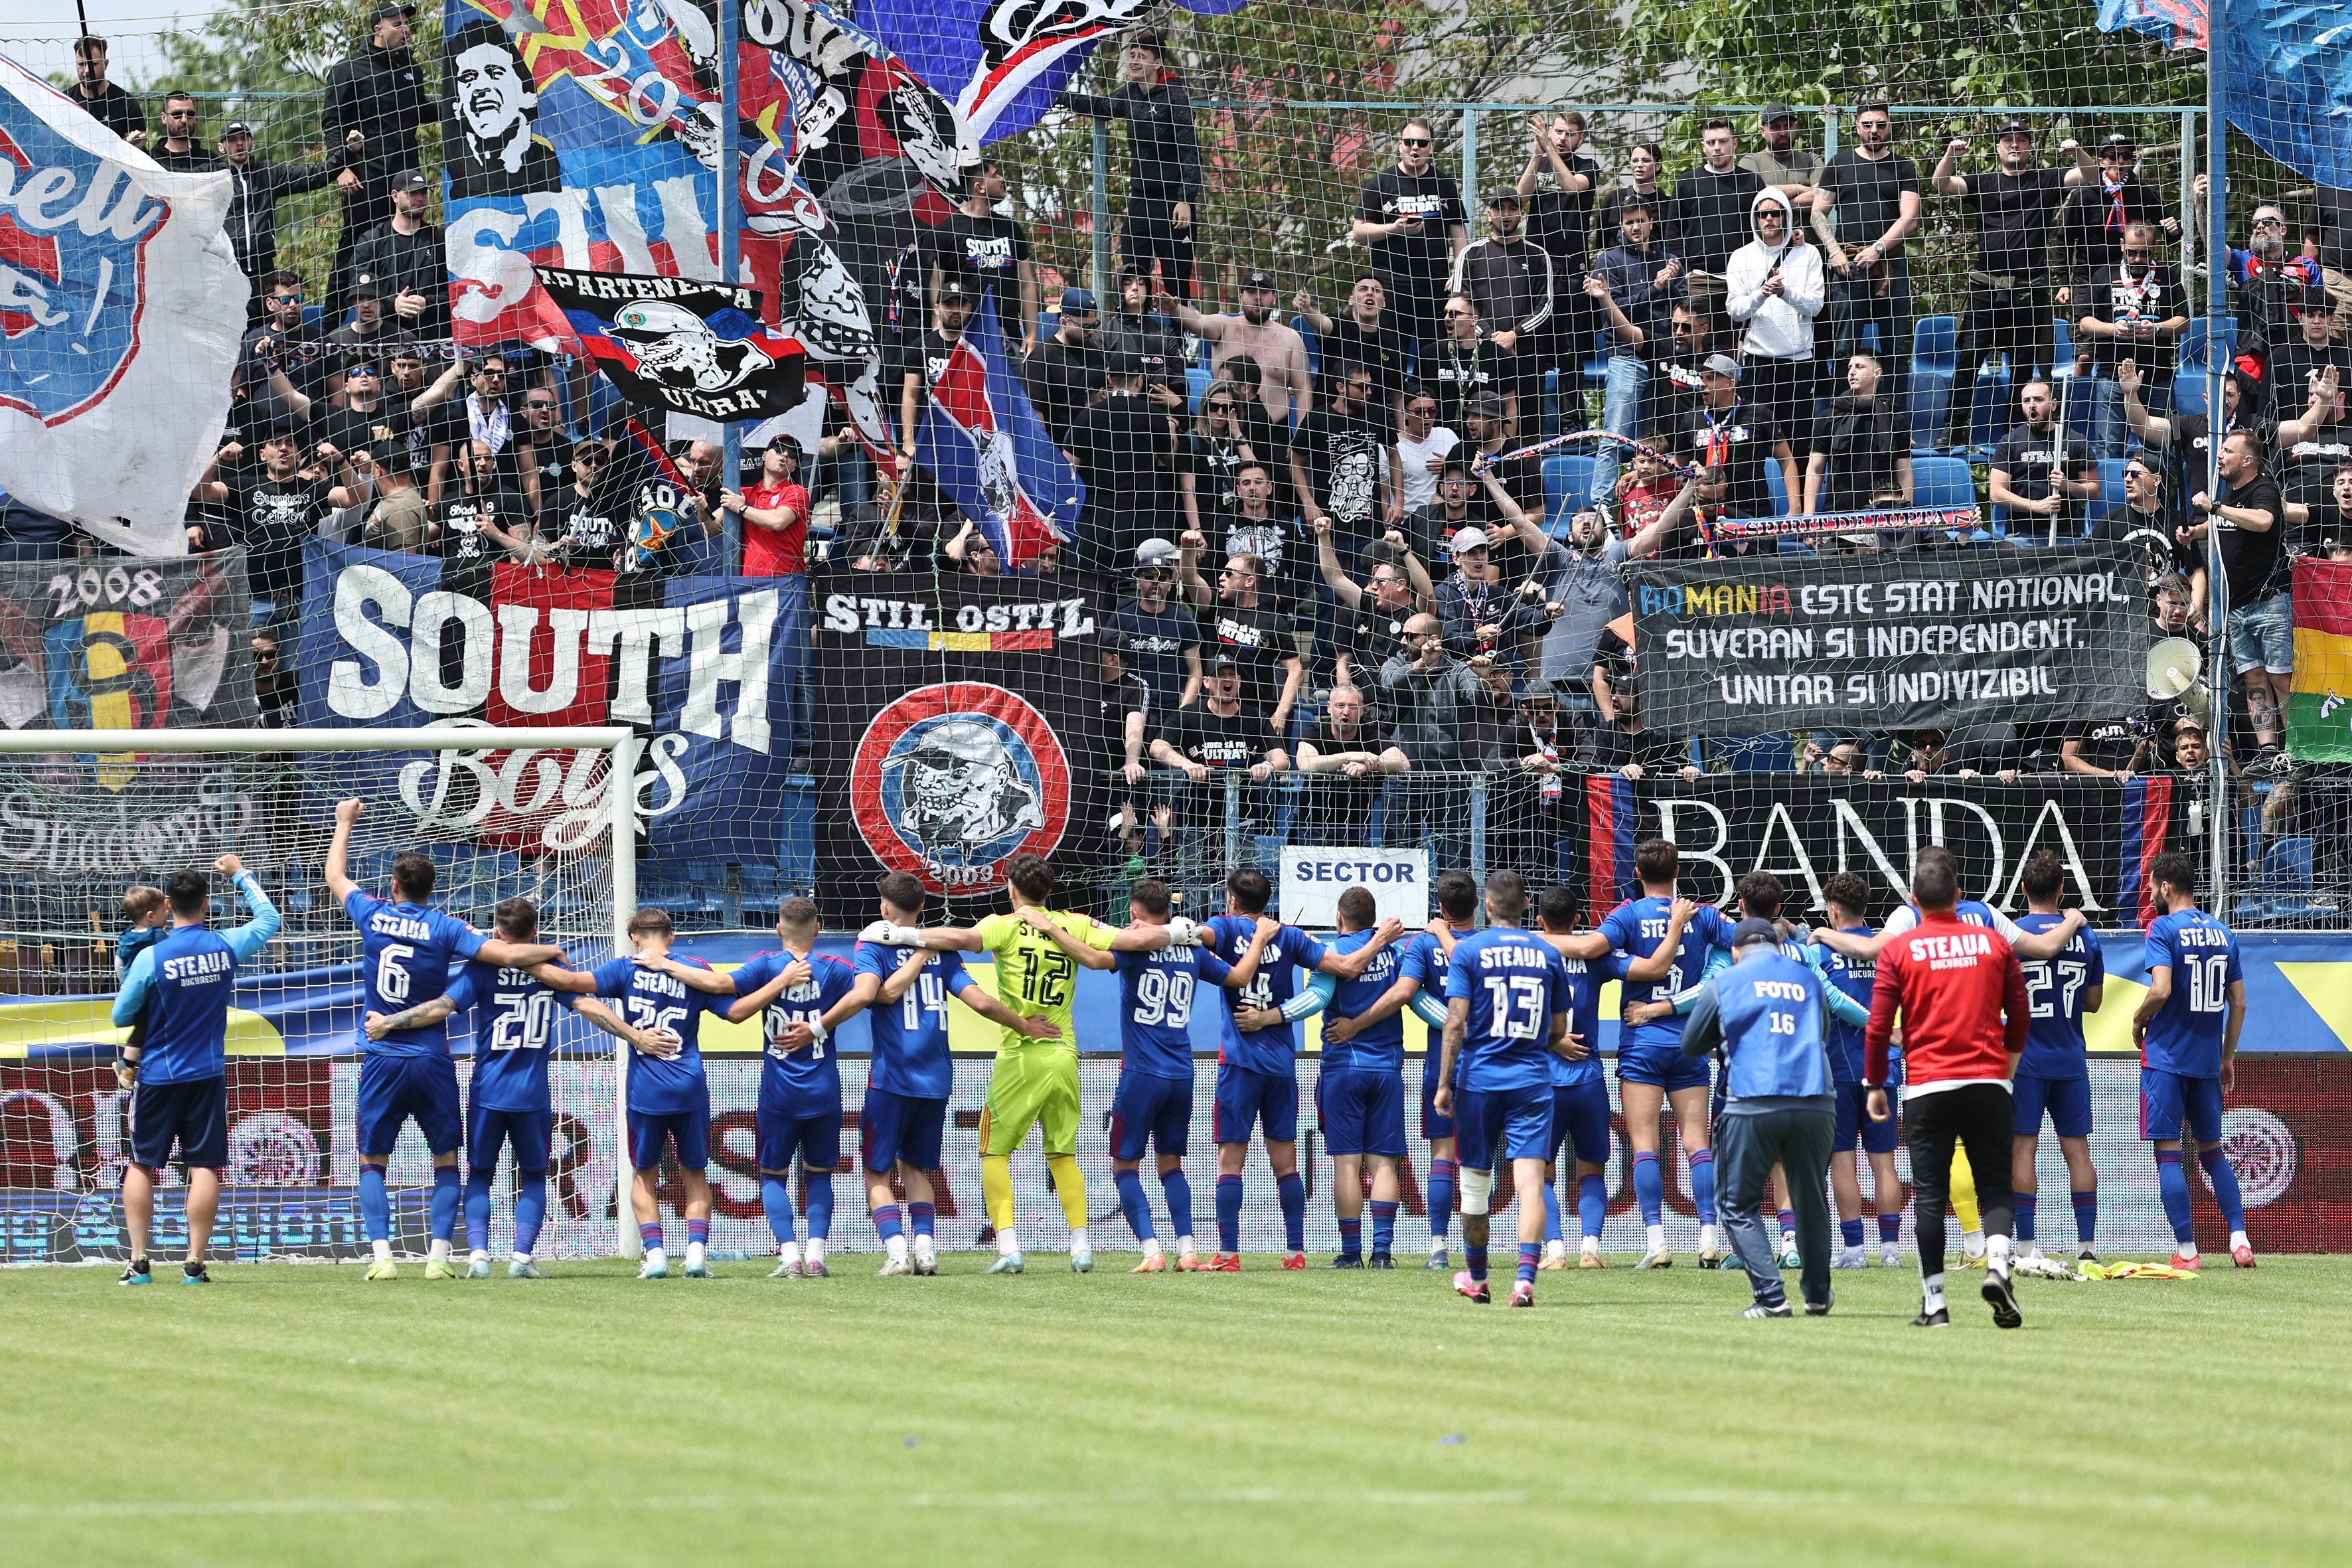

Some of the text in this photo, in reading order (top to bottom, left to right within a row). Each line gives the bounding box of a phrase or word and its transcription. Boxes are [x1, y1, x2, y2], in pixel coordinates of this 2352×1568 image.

[965, 236, 1012, 257] SOUTH
[977, 254, 1005, 268] Boys
[928, 356, 949, 374] SOU
[1745, 518, 1828, 536] SPIRIT
[1834, 513, 1866, 530] DE
[1871, 509, 1948, 528] LUPTA
[48, 563, 165, 619] 2008
[1640, 572, 2130, 616] ROMANIA ESTE STAT NATIONAL,
[824, 593, 933, 634] STIL
[1666, 627, 1814, 661] SUVERAN
[1825, 626, 1855, 659] SI
[1866, 617, 2084, 657] INDEPENDENT,
[327, 564, 779, 755] SOUTH
[1720, 666, 2057, 706] UNITAR SI INDIVIZIBIL
[398, 719, 687, 851] Boys
[1648, 797, 2109, 913] BANDA
[929, 862, 994, 886] 2003
[1296, 862, 1415, 884] SECTOR
[370, 912, 431, 941] STEAUA
[2179, 927, 2229, 947] STEAUA
[1480, 945, 1547, 969] STEAUA
[1909, 933, 1992, 963] STEAUA
[163, 951, 232, 981] STEAUA
[181, 974, 221, 988] BUCURESTI
[376, 944, 414, 1005] 6
[1018, 947, 1072, 1006] 12
[1848, 969, 1877, 979] BUCURE
[2184, 953, 2229, 1012] 10
[633, 970, 686, 1000] STEAUA
[901, 972, 949, 1030] 14
[1133, 968, 1194, 1029] 99
[1753, 981, 1806, 1002] FOTO
[2024, 960, 2087, 1020] 27
[491, 990, 555, 1051] 20
[1484, 975, 1545, 1040] 13
[1769, 1012, 1796, 1036] 16
